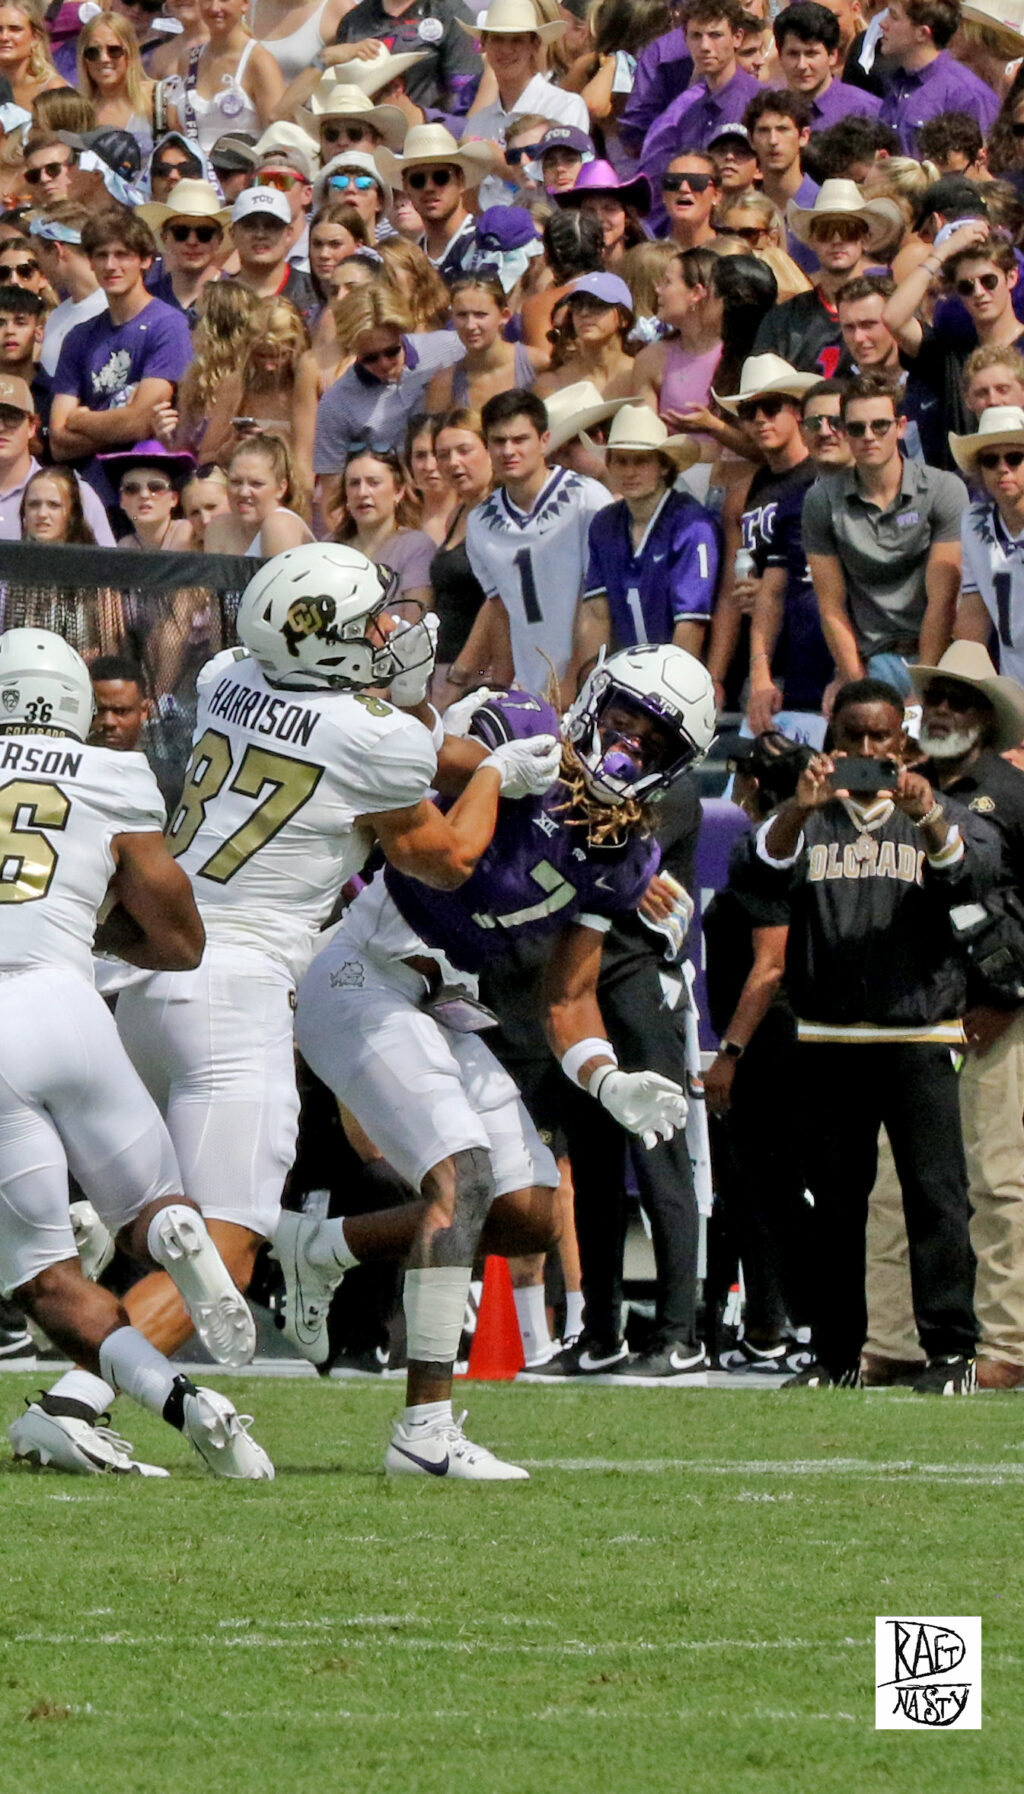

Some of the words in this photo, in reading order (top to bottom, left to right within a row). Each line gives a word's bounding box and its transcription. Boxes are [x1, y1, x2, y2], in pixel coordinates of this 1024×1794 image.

[544, 128, 570, 142] TCU
[251, 195, 274, 204] TCU
[513, 546, 544, 624] 1
[697, 543, 708, 578] 1
[992, 572, 1022, 648] 1
[24, 702, 53, 724] 36
[207, 679, 321, 747] HARRISON
[166, 728, 325, 885] 87
